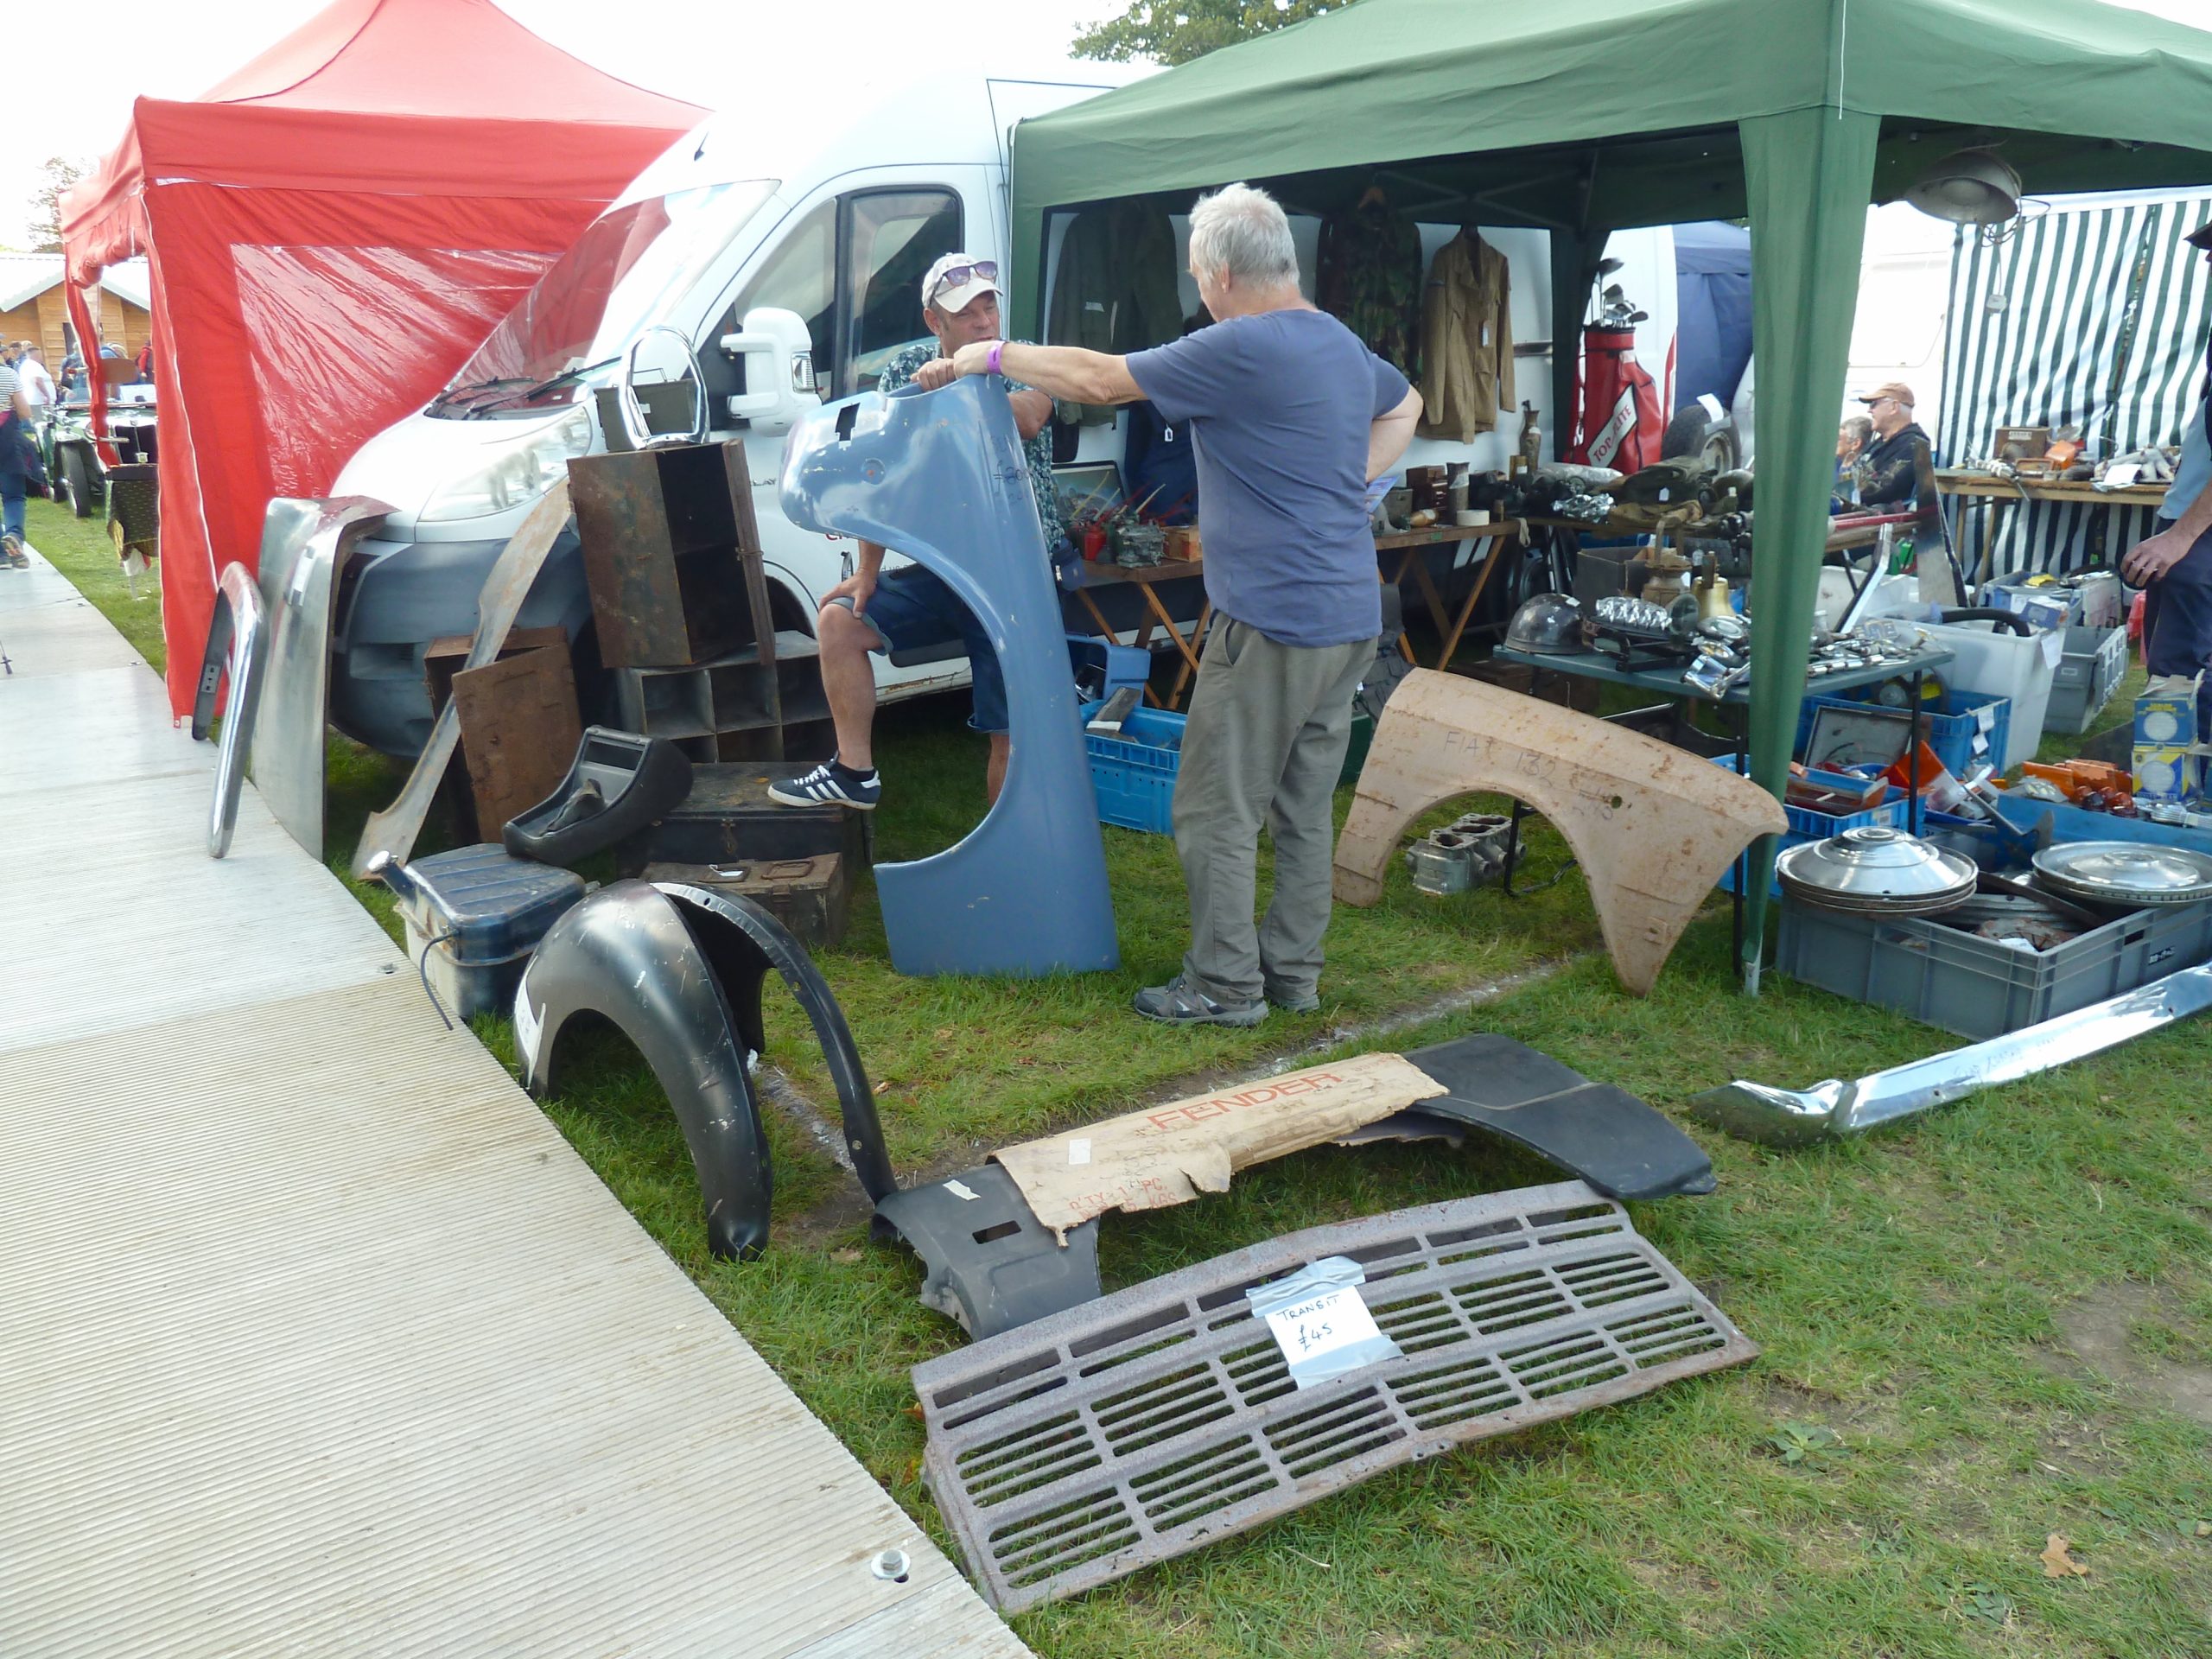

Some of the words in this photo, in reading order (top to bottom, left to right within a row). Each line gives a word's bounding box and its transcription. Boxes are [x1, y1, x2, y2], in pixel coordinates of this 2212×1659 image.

[1593, 435, 1612, 462] TOP
[1147, 1072, 1343, 1129] FENDER
[1275, 1294, 1340, 1321] TRANSIT
[1298, 1322, 1333, 1353] £45
